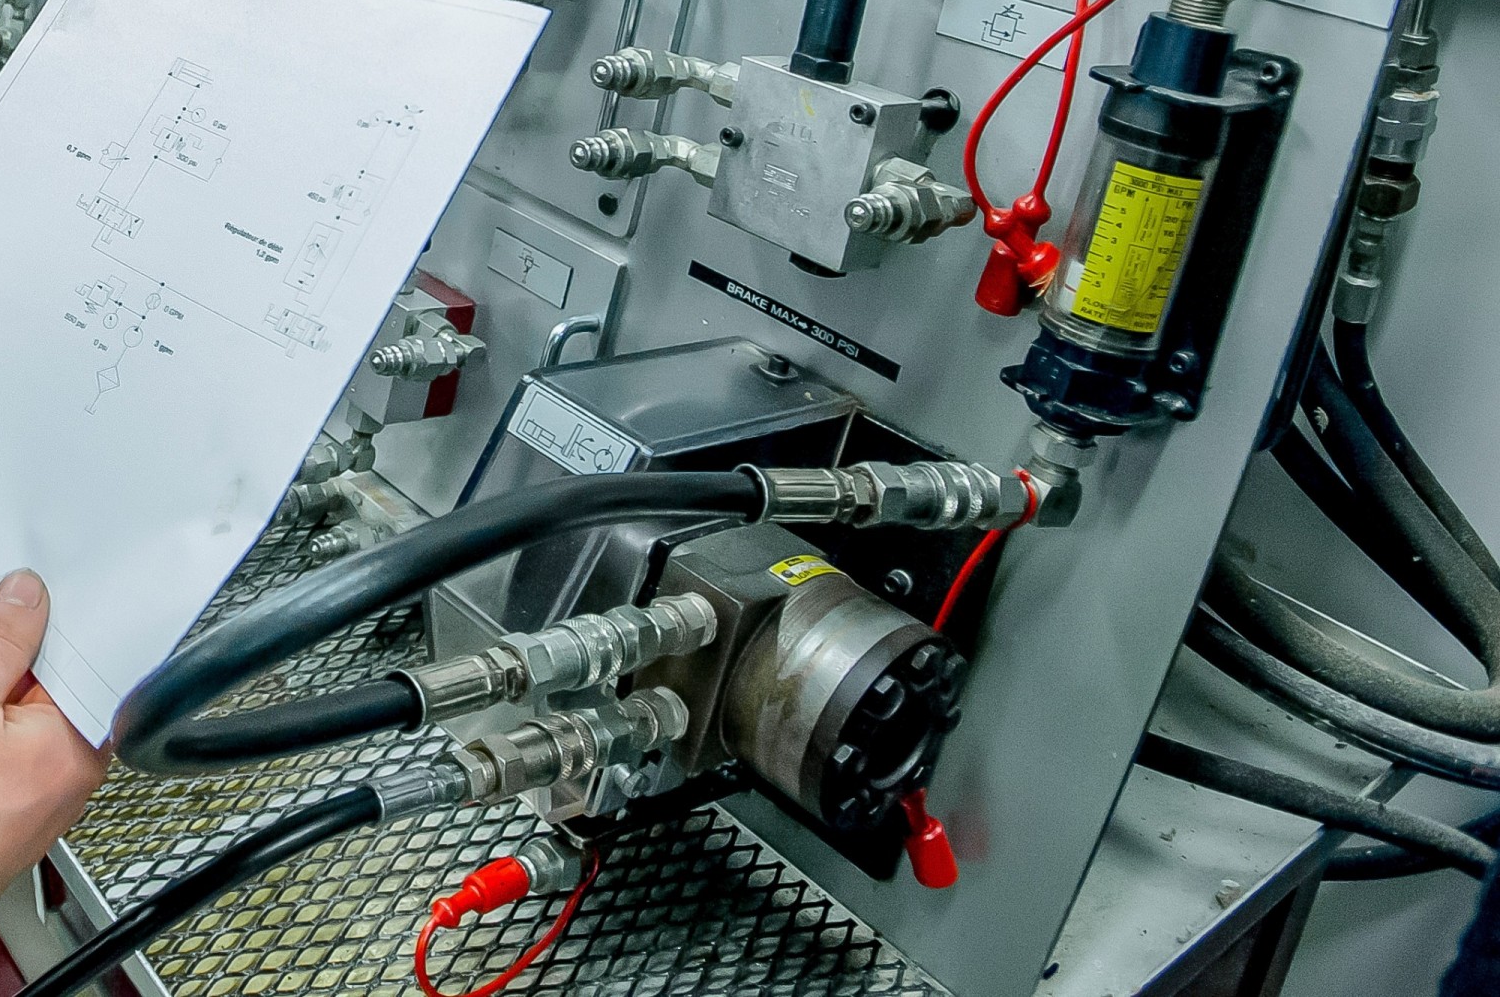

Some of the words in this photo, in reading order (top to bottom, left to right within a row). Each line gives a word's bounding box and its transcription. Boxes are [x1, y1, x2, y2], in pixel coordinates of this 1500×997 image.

[1113, 185, 1137, 199] GPM
[1110, 237, 1117, 245] 3
[1105, 255, 1113, 263] 2
[726, 281, 768, 311] BRAKE
[770, 304, 800, 326] MAX
[811, 325, 835, 344] 300
[837, 338, 860, 358] PSI
